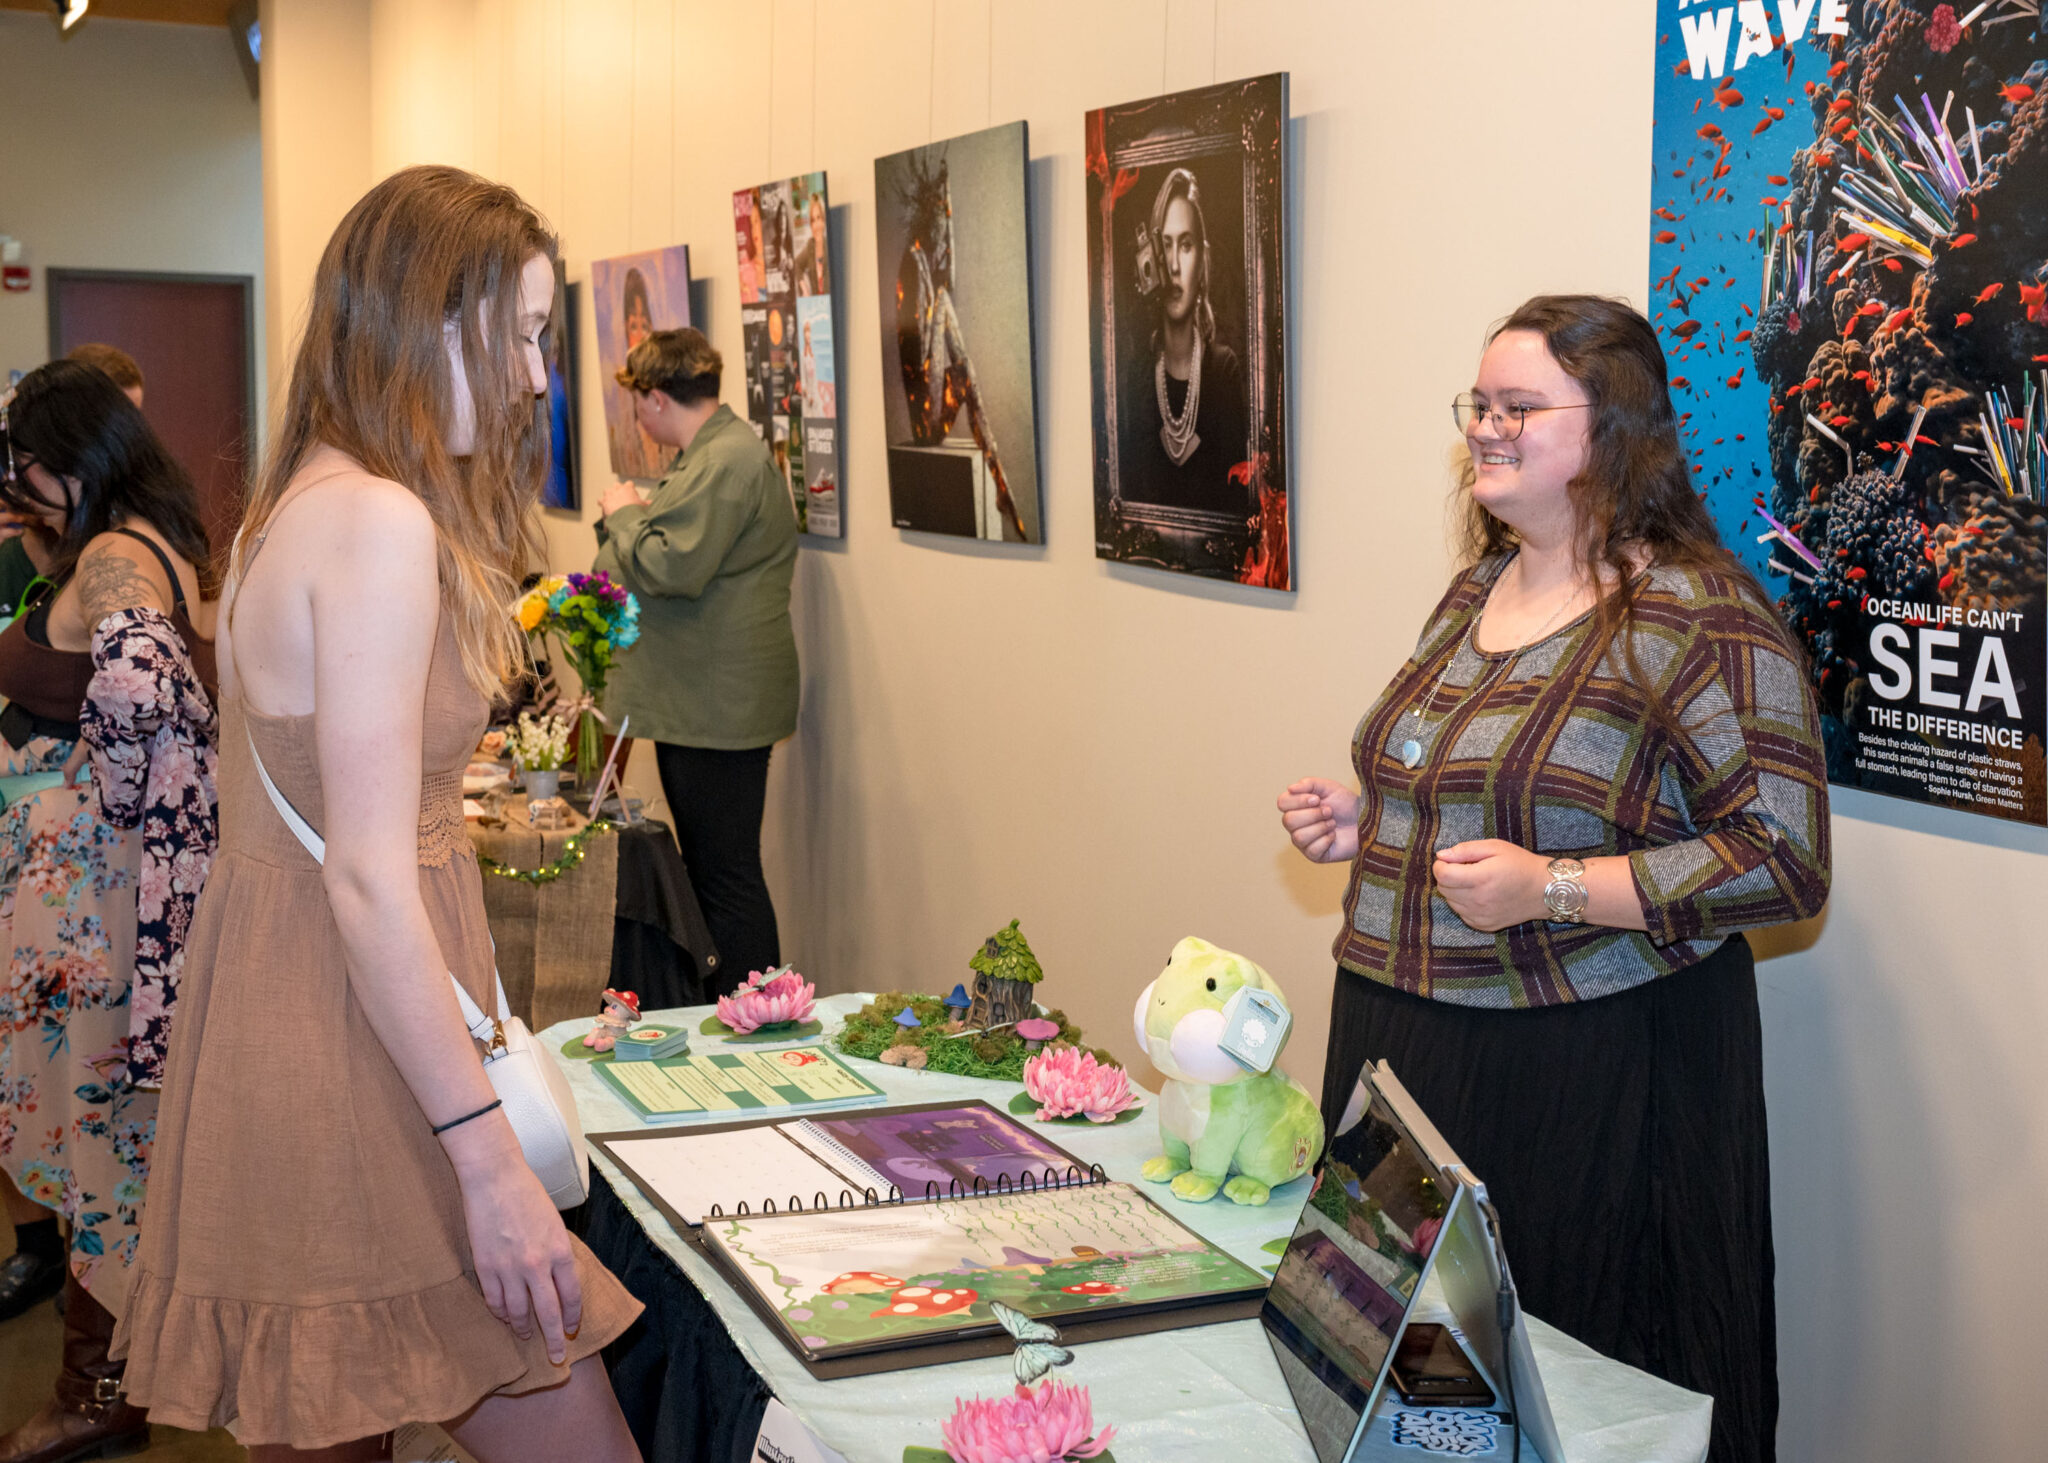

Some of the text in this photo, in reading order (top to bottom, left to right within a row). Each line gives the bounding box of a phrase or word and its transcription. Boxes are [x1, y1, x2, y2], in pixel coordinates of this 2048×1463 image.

[1679, 0, 1850, 80] WAVE
[1867, 597, 2023, 632] OCEANLIFE CAN'T
[1868, 623, 2023, 719] SEA
[1868, 706, 2023, 750] THE DIFFERENCE
[1858, 732, 2023, 772] Besides the choking hazard of plastic straws,
[1863, 746, 1876, 757] this
[1877, 751, 1899, 761] sends
[1900, 754, 1928, 767] animals
[1936, 759, 1954, 771] false
[1955, 766, 1978, 776] sense
[1980, 768, 1988, 778] of
[1989, 769, 2016, 785] having
[1855, 757, 2023, 799] full stomach, leading them to die of starvation.
[1928, 784, 1951, 796] Sophie
[1975, 794, 1996, 805] Green
[1997, 798, 2023, 810] Matters
[1427, 1411, 1462, 1451] DOES
